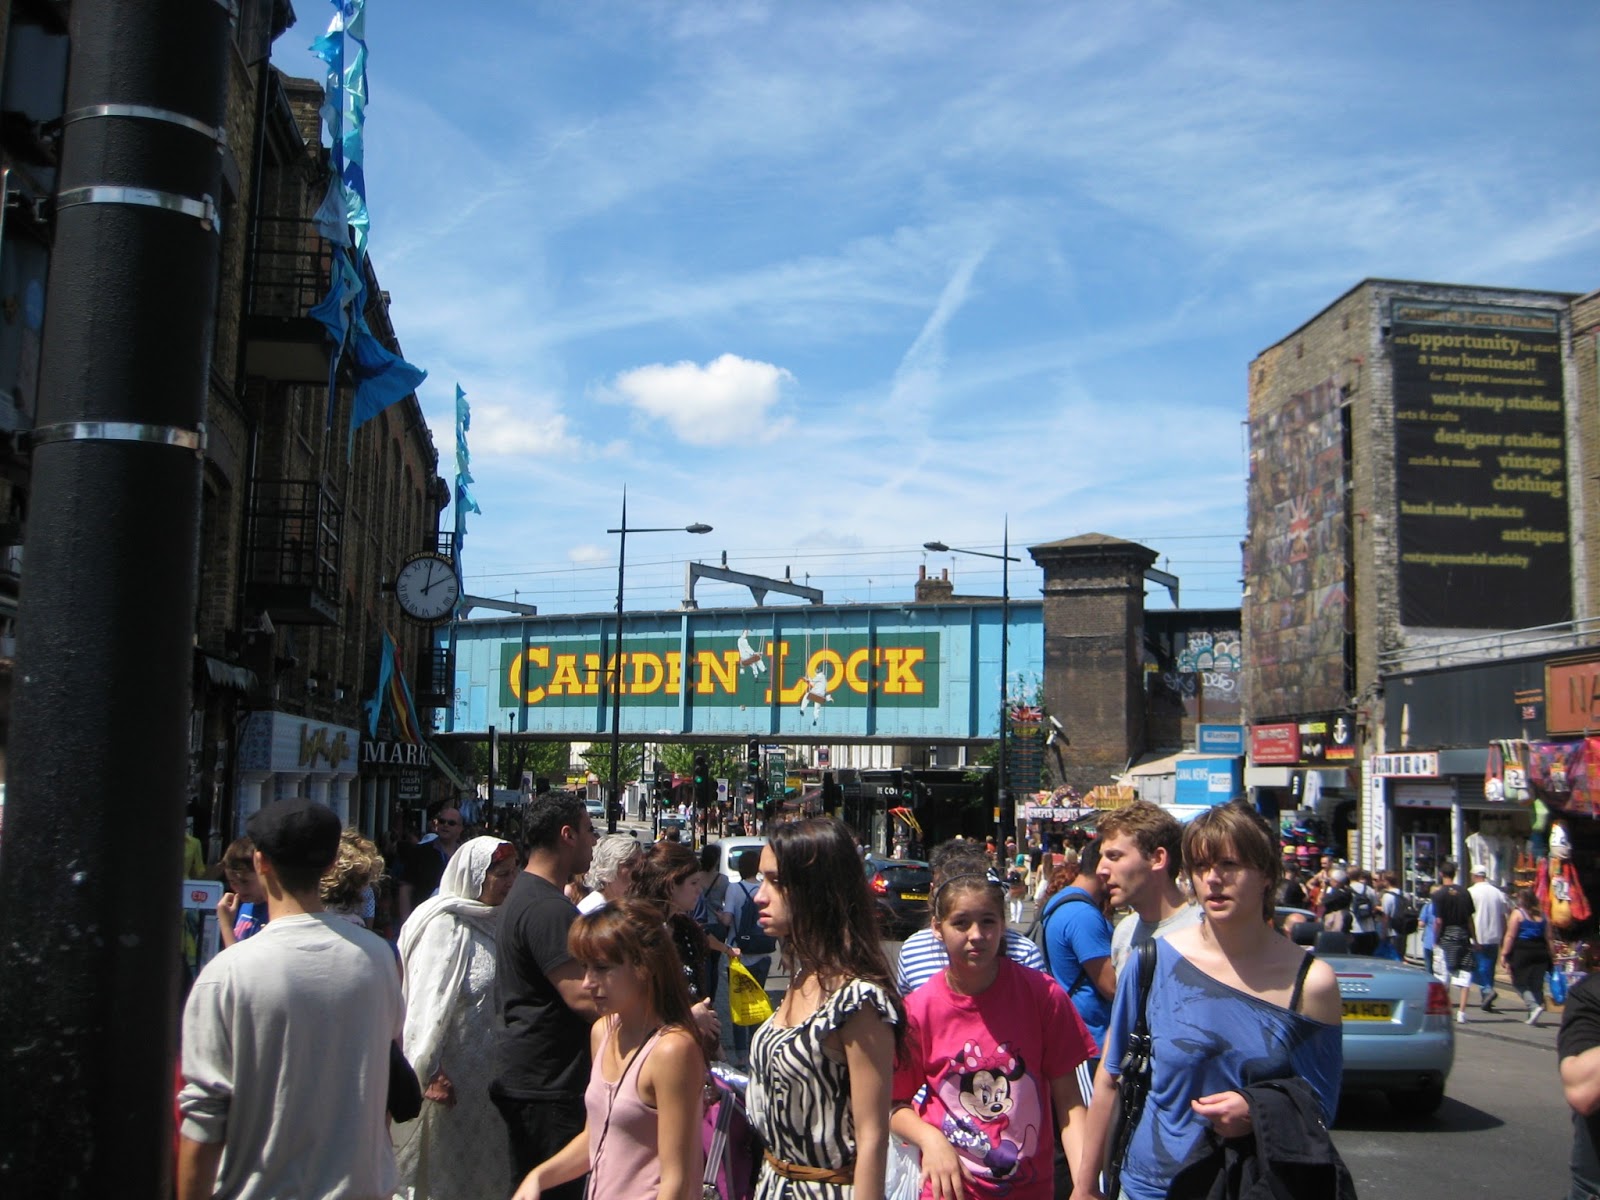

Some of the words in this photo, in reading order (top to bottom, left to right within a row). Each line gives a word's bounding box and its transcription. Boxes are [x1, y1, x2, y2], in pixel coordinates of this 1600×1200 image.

[1409, 333, 1520, 355] opportunity
[1418, 355, 1427, 365] a
[1430, 355, 1460, 366] new
[1462, 353, 1536, 371] business!!
[1430, 372, 1443, 381] for
[1444, 372, 1489, 385] anyone
[1431, 392, 1504, 412] workshop
[1507, 395, 1560, 411] studios
[1396, 411, 1417, 420] arts
[1430, 411, 1460, 422] crafts
[1434, 427, 1501, 449] designer
[1504, 432, 1560, 449] studios
[1408, 456, 1439, 466] media
[1451, 458, 1481, 468] music
[1497, 452, 1561, 474] vintage
[1492, 474, 1563, 498] clothing
[1402, 501, 1433, 514] hand
[1435, 503, 1468, 516] made
[1470, 504, 1524, 520] products
[1502, 528, 1565, 546] antiques
[405, 551, 434, 563] CAMDEN
[1488, 554, 1529, 569] activity
[509, 646, 740, 704] CAMDEN
[765, 640, 926, 704] LOCK
[402, 768, 419, 776] free
[401, 784, 419, 792] here
